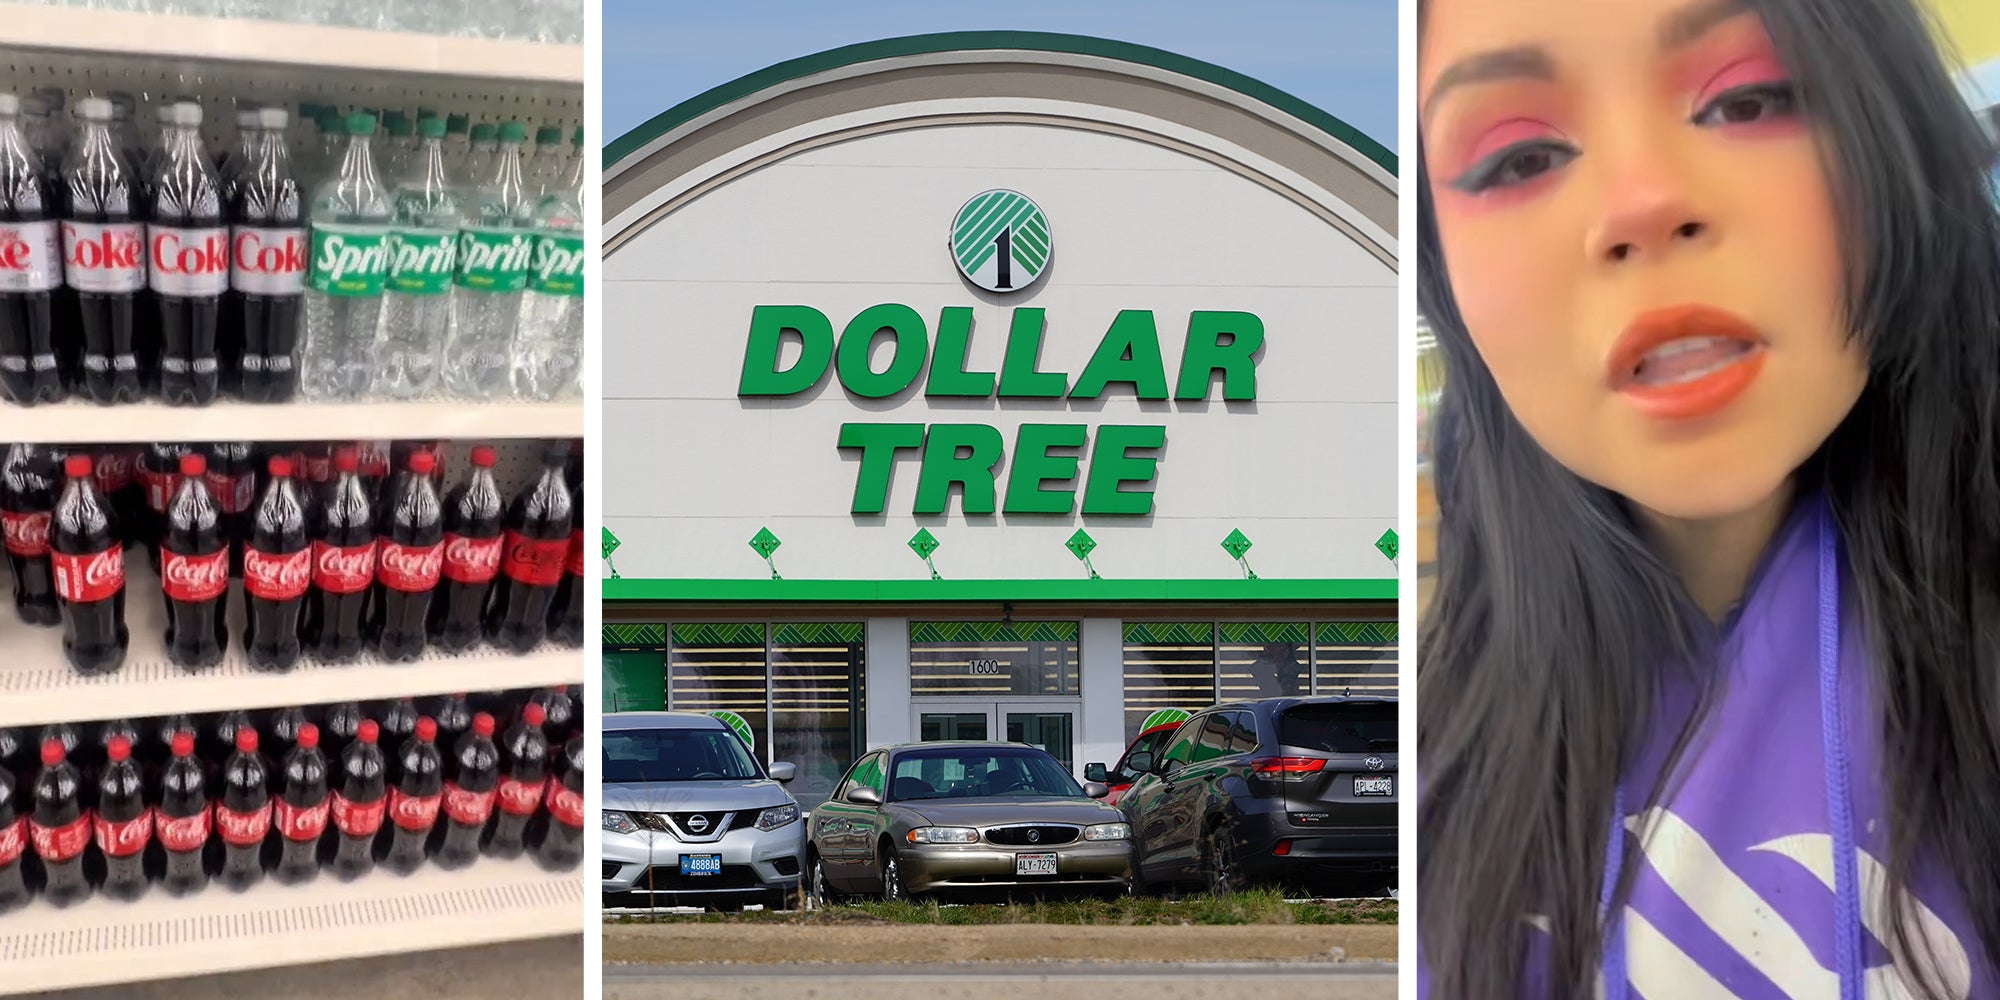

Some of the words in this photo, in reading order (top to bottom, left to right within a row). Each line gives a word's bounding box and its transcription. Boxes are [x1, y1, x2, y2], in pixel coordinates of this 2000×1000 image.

[531, 239, 584, 280] Spr
[993, 225, 1013, 289] 1
[737, 303, 1265, 401] DOLLAR
[837, 422, 1167, 515] TREE
[971, 661, 998, 674] 1600
[1018, 860, 1056, 871] ALY-7279
